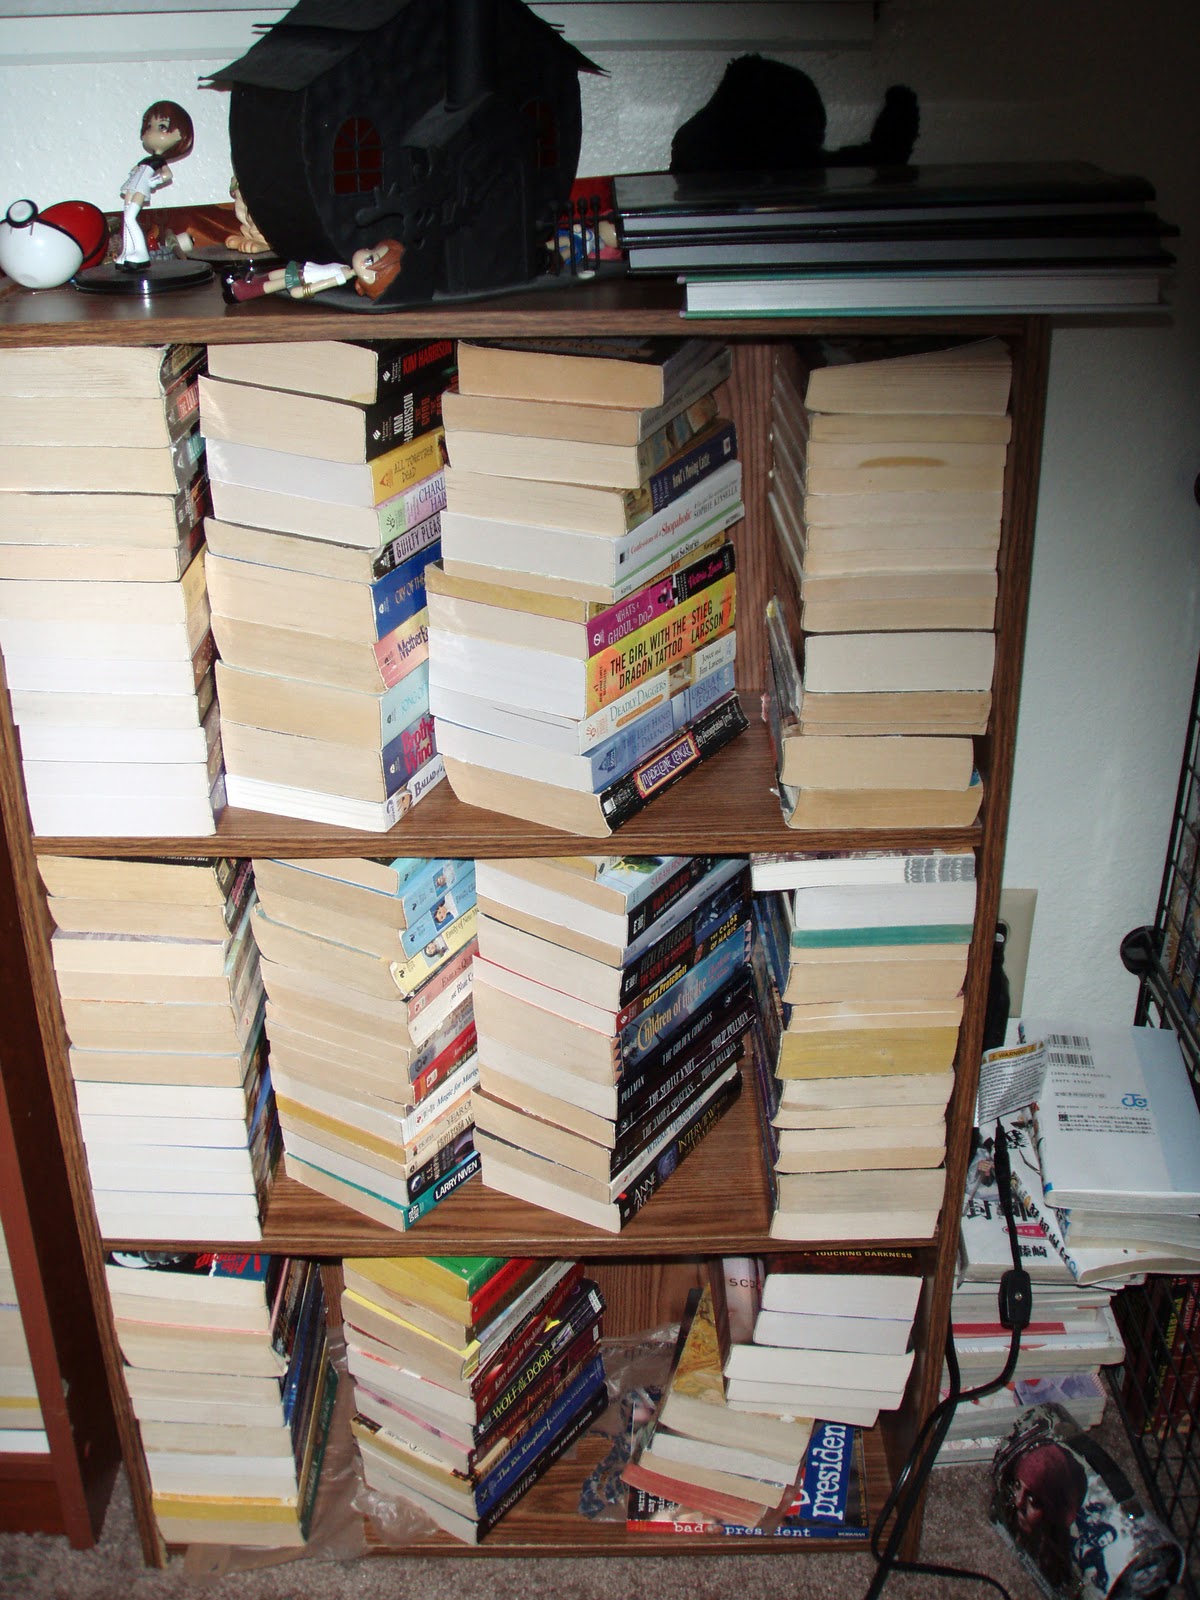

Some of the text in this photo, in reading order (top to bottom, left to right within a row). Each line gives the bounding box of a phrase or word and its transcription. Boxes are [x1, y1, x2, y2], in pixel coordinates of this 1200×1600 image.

[403, 353, 417, 375] KIM
[394, 413, 403, 434] KIM
[403, 392, 413, 443] HARRISON
[394, 460, 405, 474] ALL
[401, 466, 417, 483] DEAD
[694, 502, 713, 518] SOPHIE
[713, 485, 738, 507] KINSELLA
[661, 508, 692, 536] Shopaholic
[396, 529, 420, 560] GUILTY
[691, 599, 713, 625] STIEG
[691, 610, 724, 644] LARSSON
[608, 625, 634, 645] GHOUL
[611, 616, 687, 677] THE GIRL WITH THE
[619, 637, 683, 691] DRAGON TATTOO
[610, 699, 638, 722] DEADLY
[638, 679, 667, 706] DAGGERS
[691, 678, 719, 700] URSULA
[403, 736, 433, 775] Wind
[641, 756, 676, 792] MADELEINE
[445, 923, 459, 940] Emily
[718, 924, 738, 944] MAGIC
[643, 991, 660, 1009] Terry
[659, 964, 688, 995] Pratchett
[637, 1008, 672, 1051] Children
[437, 1089, 454, 1106] Magic
[659, 1074, 680, 1099] SUBTLE
[446, 1105, 464, 1125] YEAR
[435, 1159, 478, 1200] LARRY NIVEN
[633, 1171, 656, 1205] ANNE
[864, 1251, 913, 1259] DARKNESS
[492, 1385, 521, 1419] WOLF
[526, 1349, 553, 1383] DOOR
[520, 1424, 548, 1456] Kingdom
[488, 1470, 537, 1526] MIDNIGHTERS
[673, 1521, 705, 1533] bad
